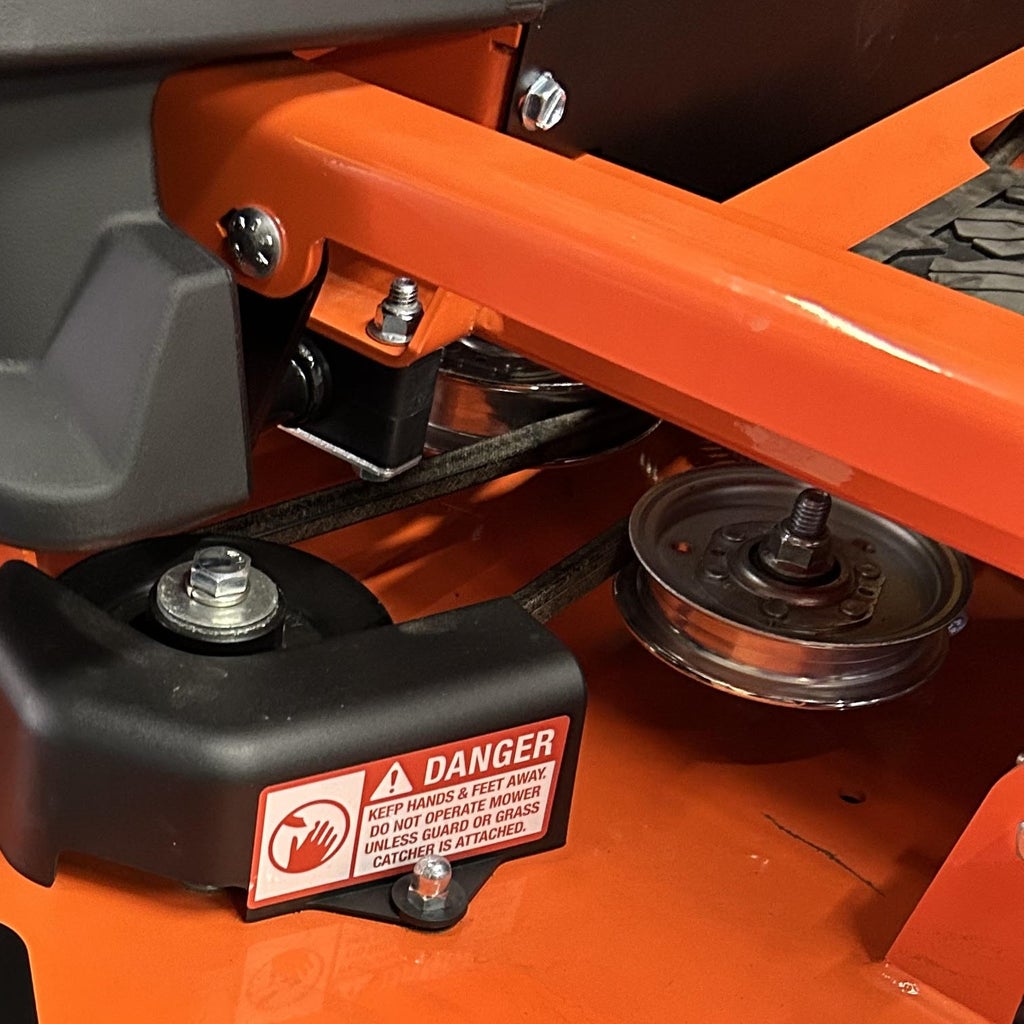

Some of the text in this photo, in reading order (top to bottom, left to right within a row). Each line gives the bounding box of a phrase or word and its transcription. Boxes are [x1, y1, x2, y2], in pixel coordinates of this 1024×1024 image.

[424, 728, 555, 785] DANGER
[370, 785, 541, 838] DO NOT OPERATE MOWER
[407, 790, 455, 812] HANDS
[457, 787, 468, 800] &
[472, 777, 505, 797] FEET
[506, 767, 547, 788] AWAY.
[365, 801, 540, 854] UNLESS GUARD OR GRASS
[373, 821, 526, 868] CATCHER IS ATTACHED.
